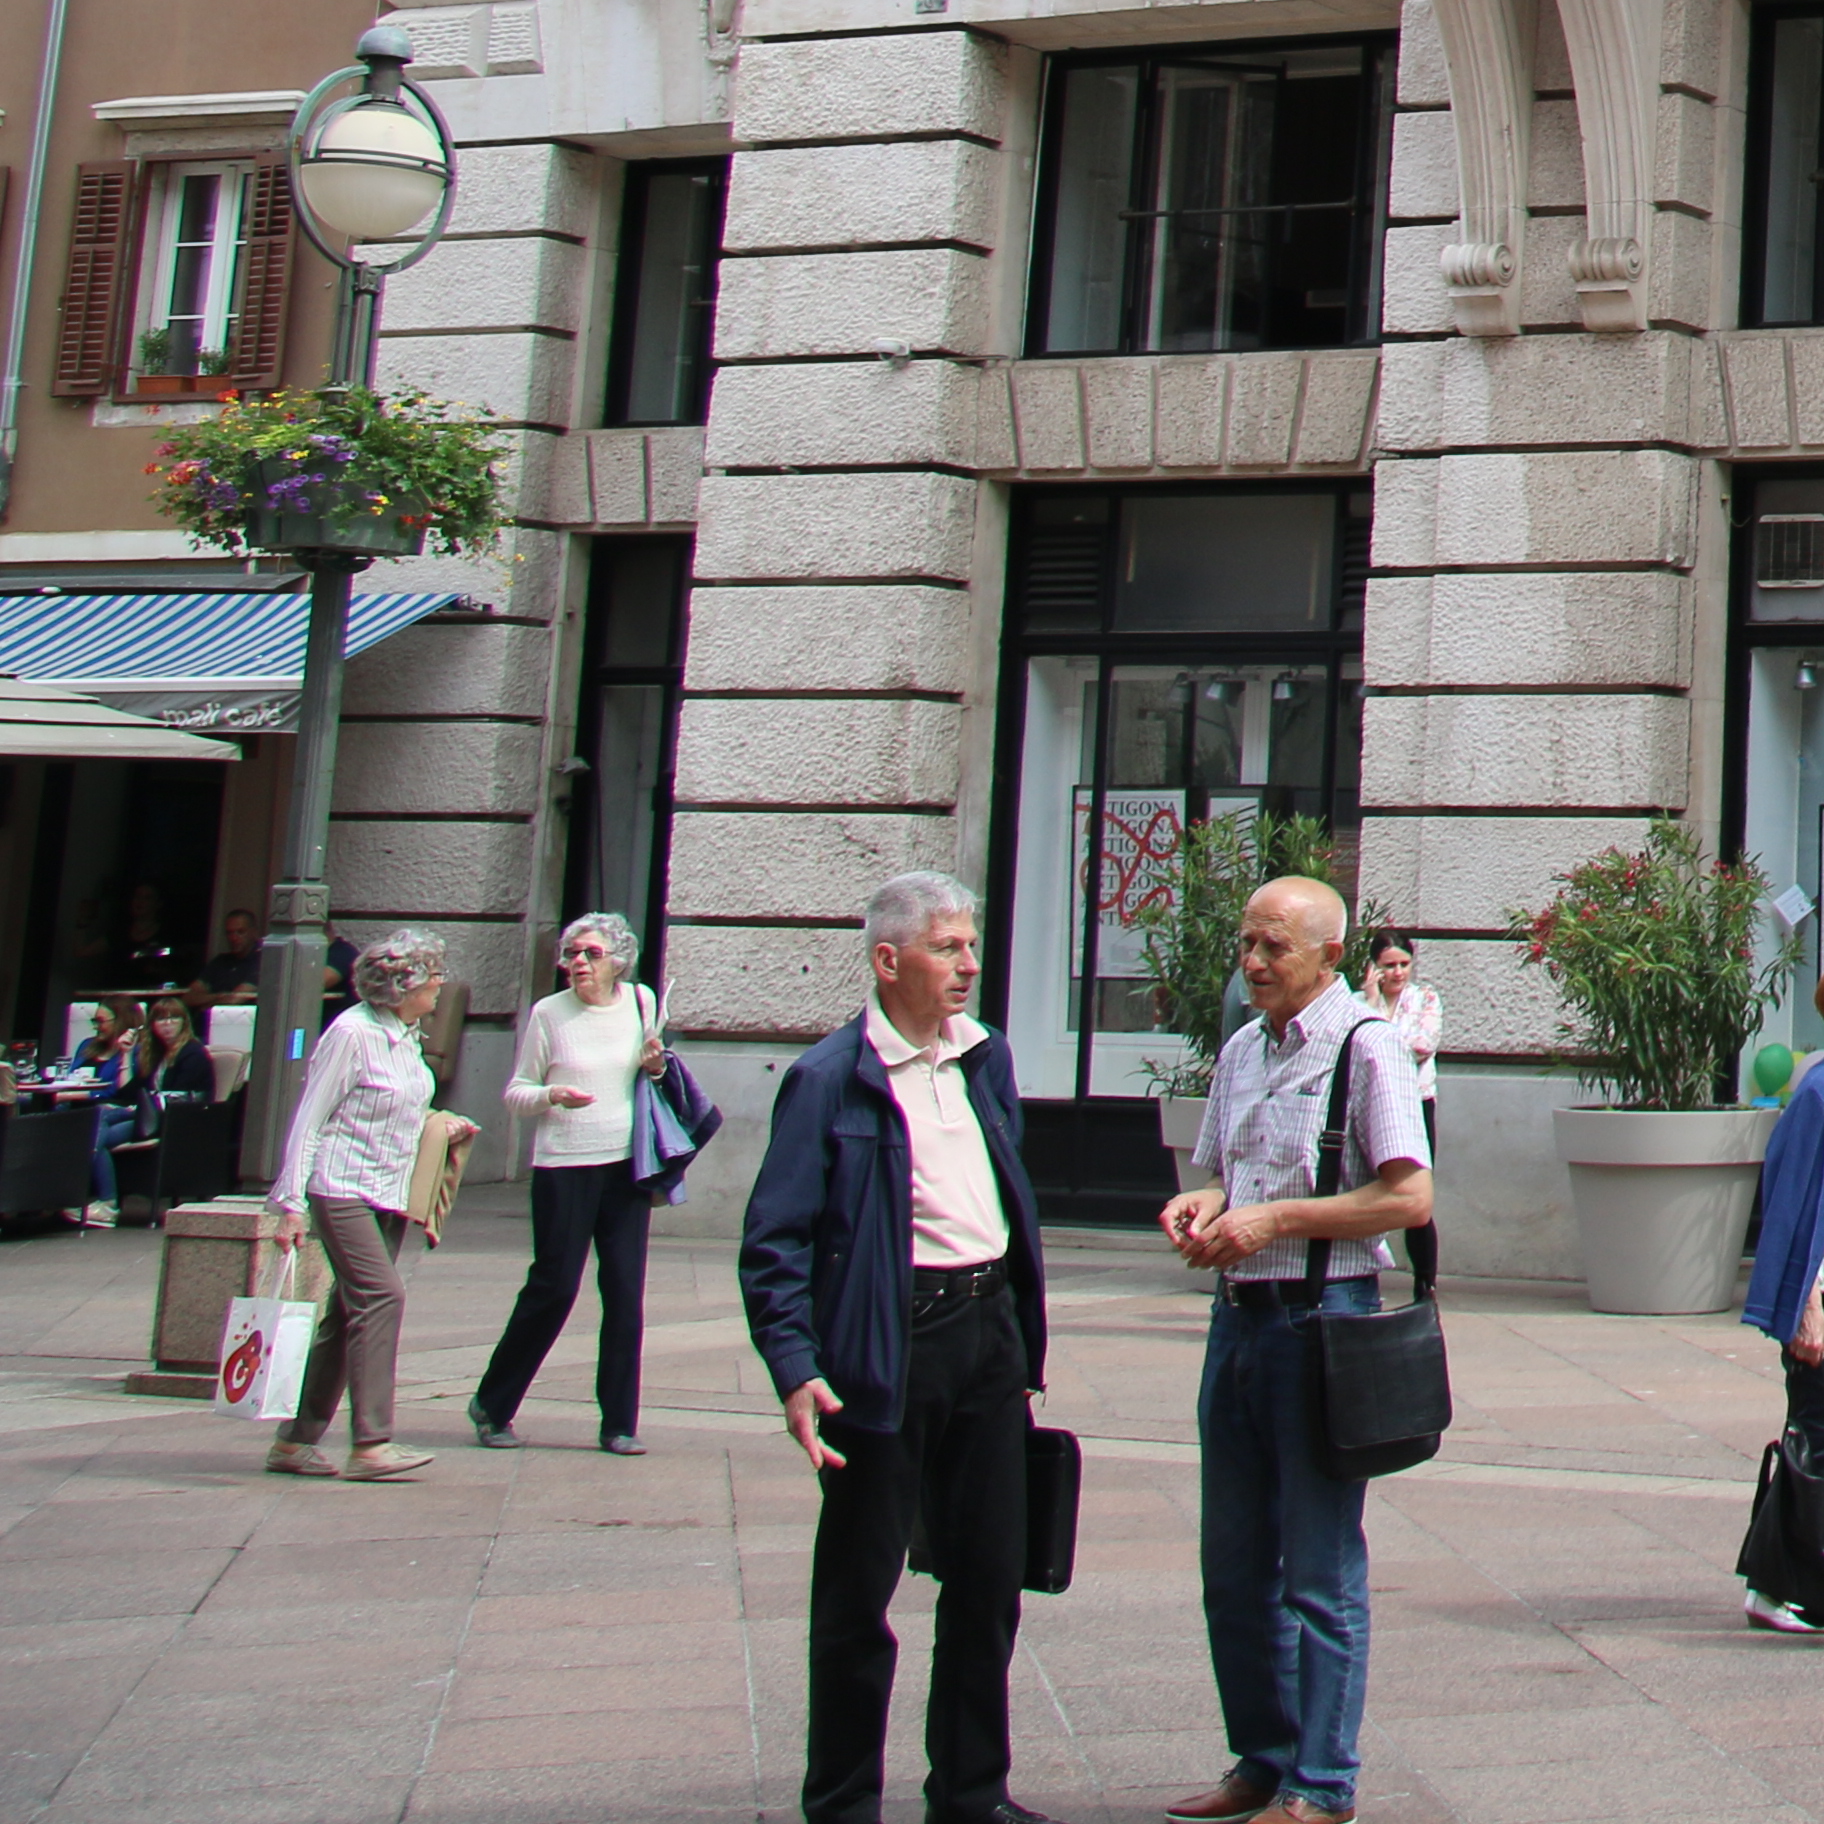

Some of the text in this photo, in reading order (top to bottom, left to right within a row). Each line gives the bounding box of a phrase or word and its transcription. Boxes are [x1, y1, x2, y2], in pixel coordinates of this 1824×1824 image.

[161, 701, 283, 726] mali café
[1081, 800, 1177, 816] ATIGONA
